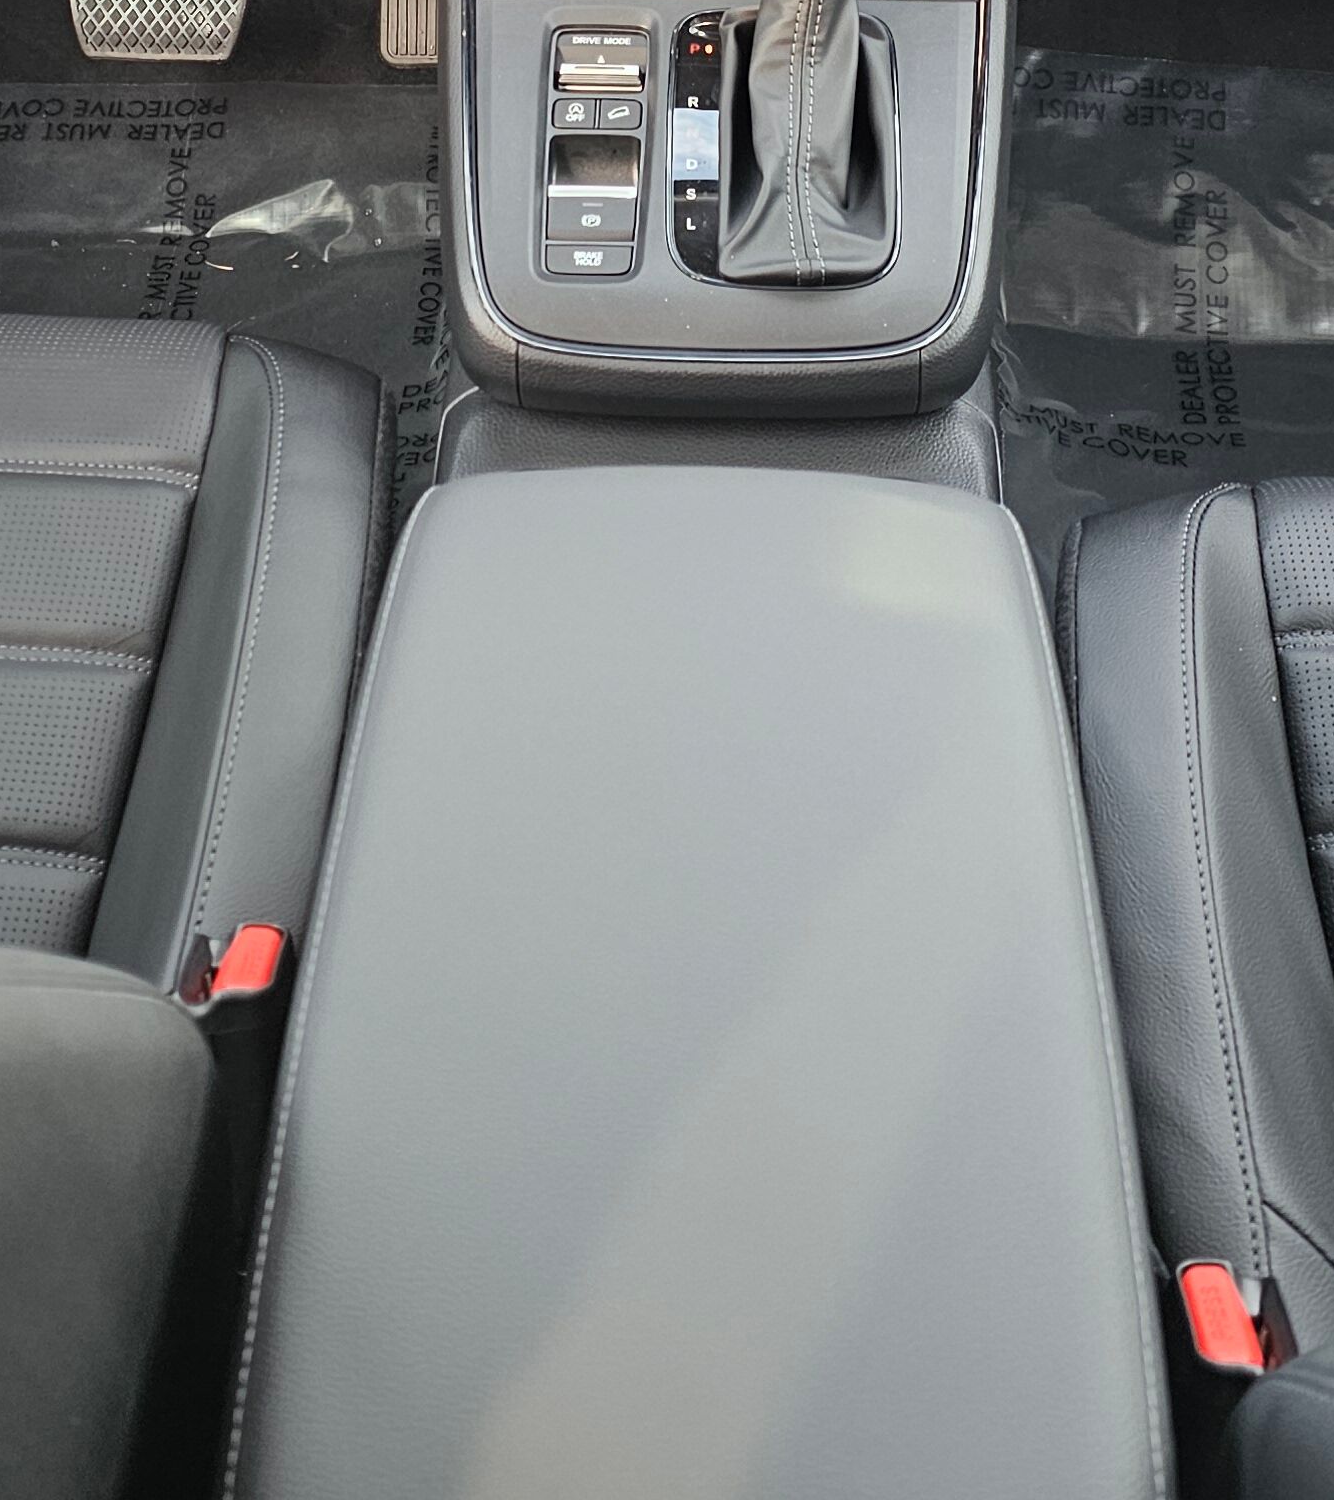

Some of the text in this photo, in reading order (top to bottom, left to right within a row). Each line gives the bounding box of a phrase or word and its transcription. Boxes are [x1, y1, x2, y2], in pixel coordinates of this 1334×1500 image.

[572, 36, 632, 45] DRIVE MODE
[690, 43, 700, 55] P
[1064, 70, 1227, 103] PROTECTIVE
[75, 97, 229, 119] PROTECTIVE
[687, 96, 699, 108] R
[565, 114, 586, 123] OFF
[1036, 98, 1227, 131] DEALER MUST
[43, 122, 225, 141] DEALER MUST
[685, 158, 698, 171] D
[685, 188, 697, 201] S
[686, 218, 697, 231] L
[573, 252, 604, 260] BRAKE
[574, 258, 602, 267] HOLD
[1172, 135, 1208, 425] DEALER MUST REMOVE
[1205, 189, 1242, 426] PROTECTIVE COVER
